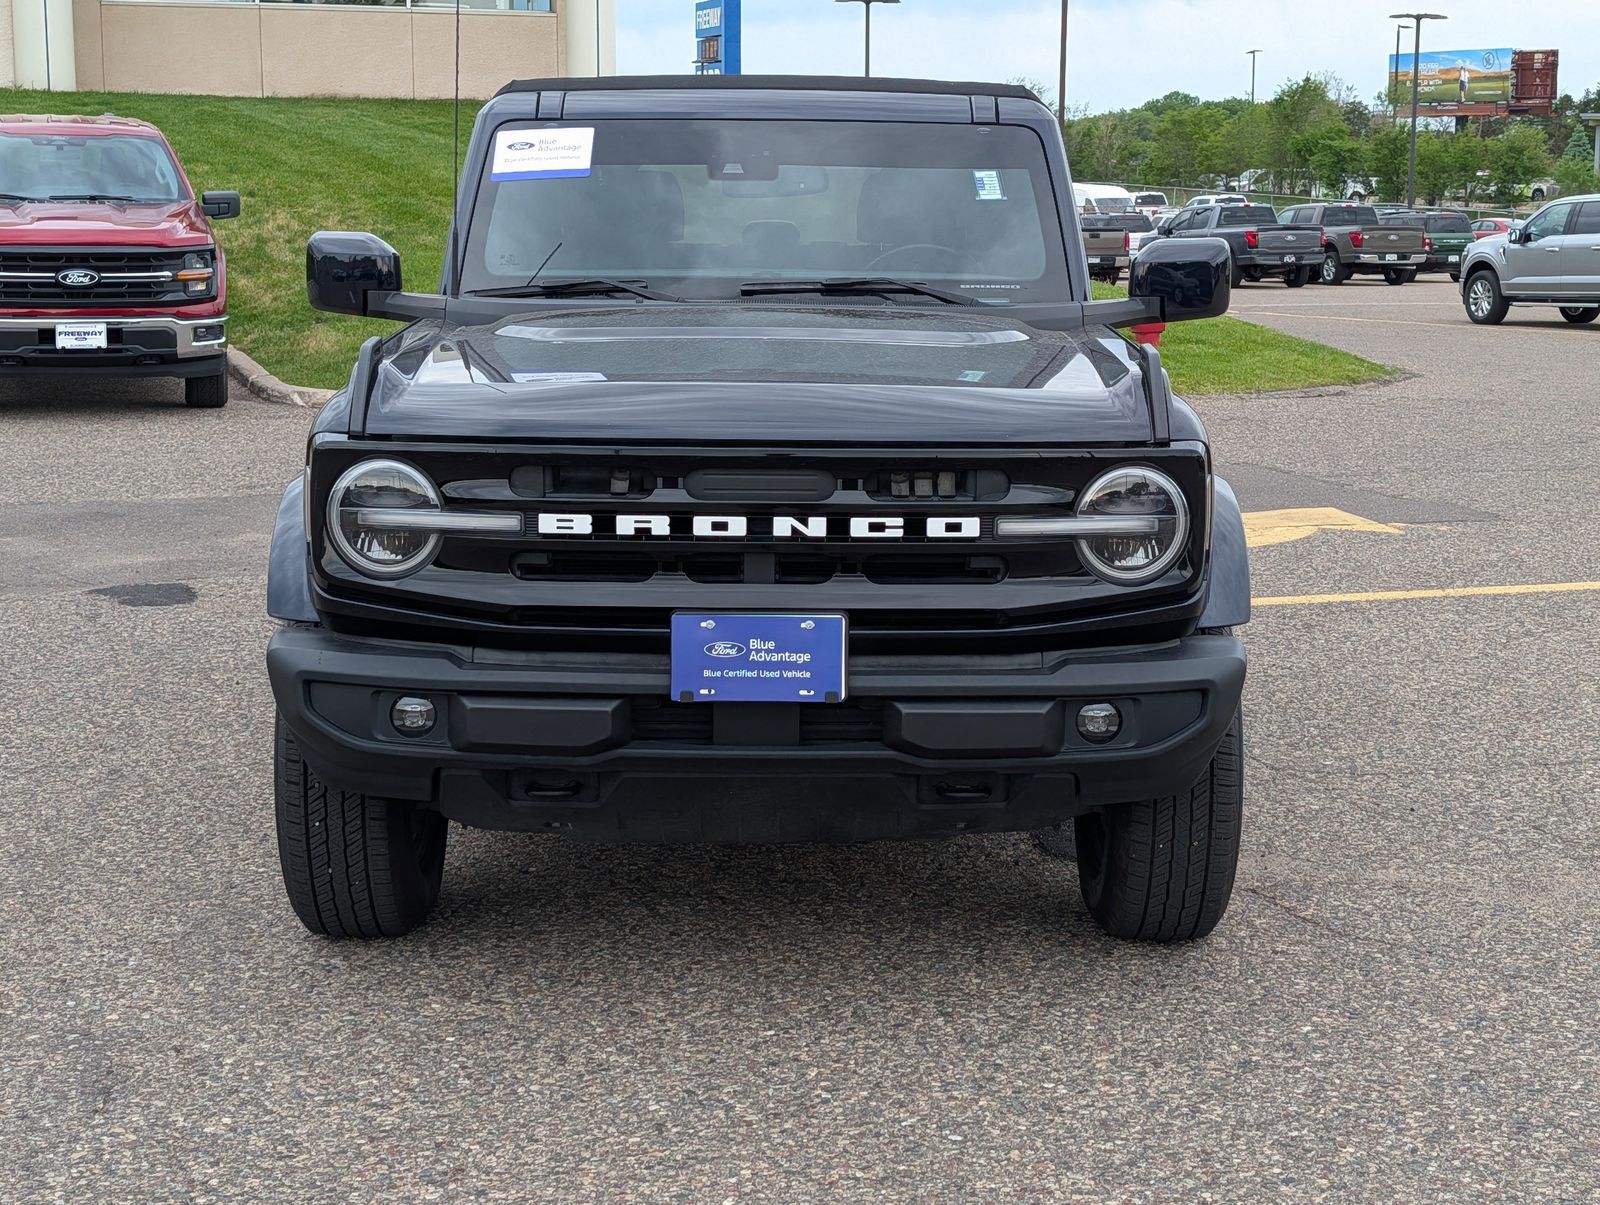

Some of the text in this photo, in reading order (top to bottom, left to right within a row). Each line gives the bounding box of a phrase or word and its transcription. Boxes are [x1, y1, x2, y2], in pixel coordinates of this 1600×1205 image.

[696, 6, 722, 30] FREEWAY
[537, 513, 981, 538] BRONCO
[749, 638, 776, 650] Blue
[748, 650, 812, 663] Advantage
[703, 669, 811, 678] Blue Certified Used Vehicle
